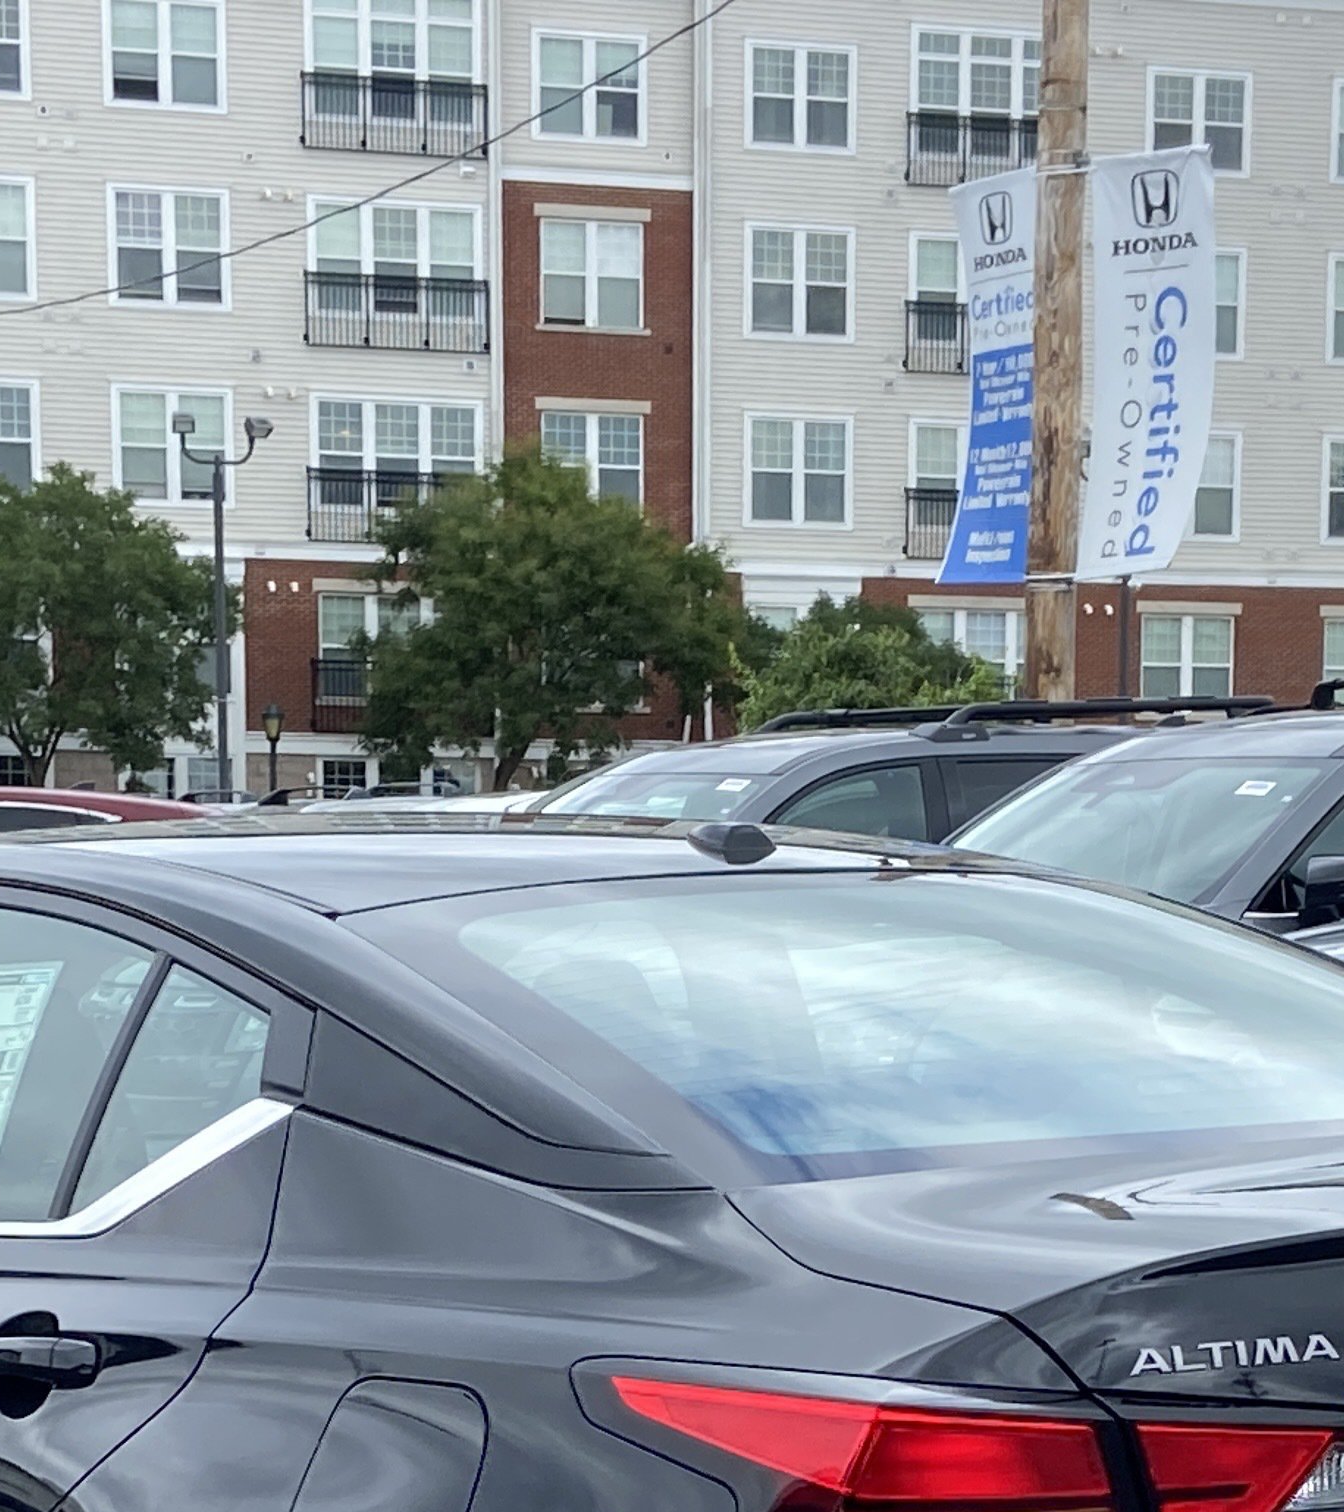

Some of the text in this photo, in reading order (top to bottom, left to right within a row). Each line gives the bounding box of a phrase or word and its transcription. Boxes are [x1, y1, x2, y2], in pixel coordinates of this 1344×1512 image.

[973, 247, 1027, 272] HONDA
[1112, 232, 1198, 257] HONDA
[1100, 293, 1147, 558] Pre-Owned
[1124, 286, 1187, 557] Certified
[1130, 1333, 1341, 1377] ALTIMA
